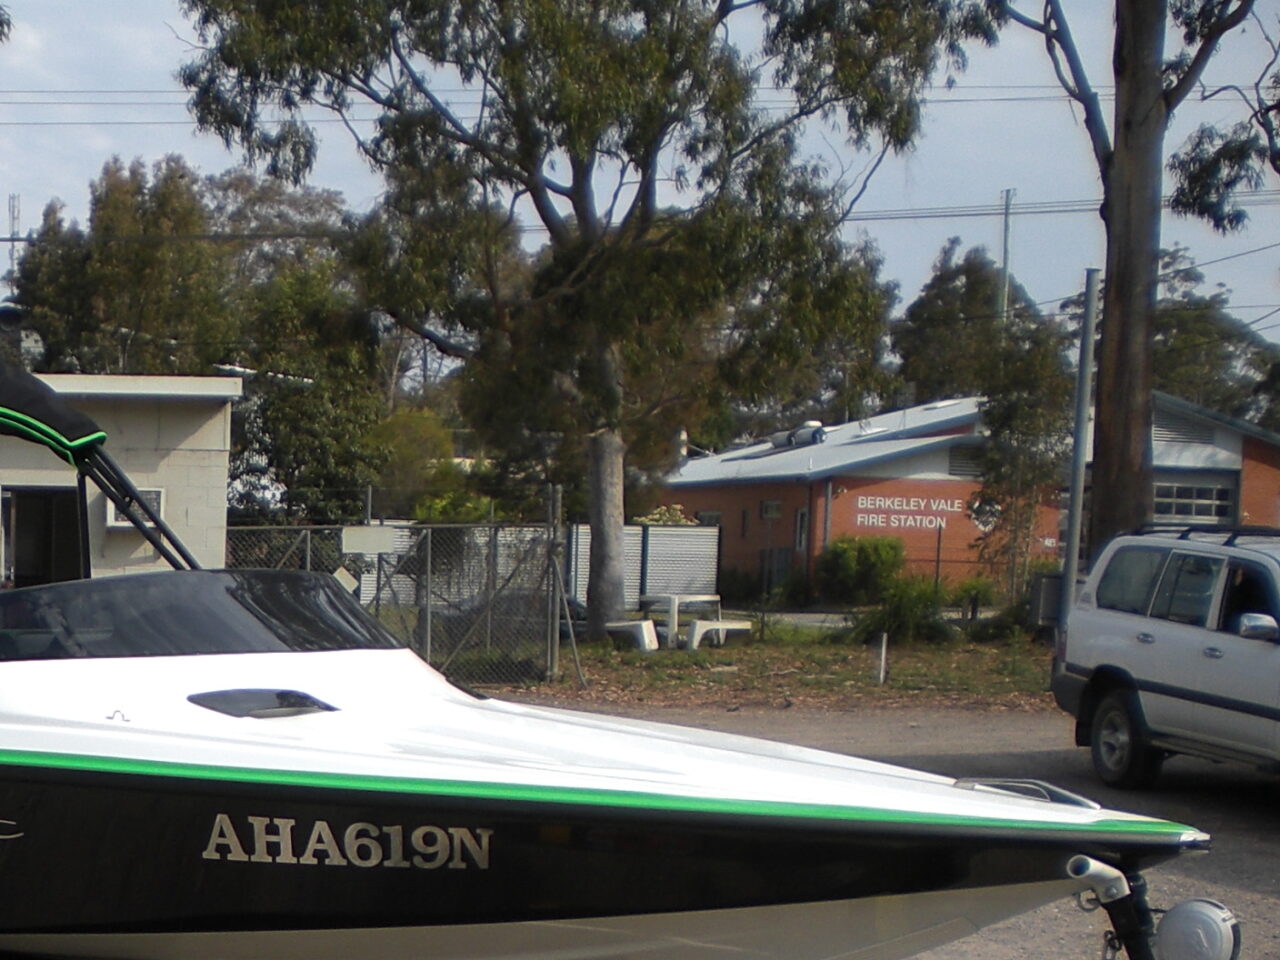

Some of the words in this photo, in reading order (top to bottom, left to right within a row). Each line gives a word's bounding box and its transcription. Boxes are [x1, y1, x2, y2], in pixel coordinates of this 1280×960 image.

[858, 496, 928, 510] BERKELEY
[930, 499, 962, 511] VALE
[856, 514, 887, 527] FIRE
[890, 515, 946, 528] STATION
[202, 813, 495, 870] AHA619N
